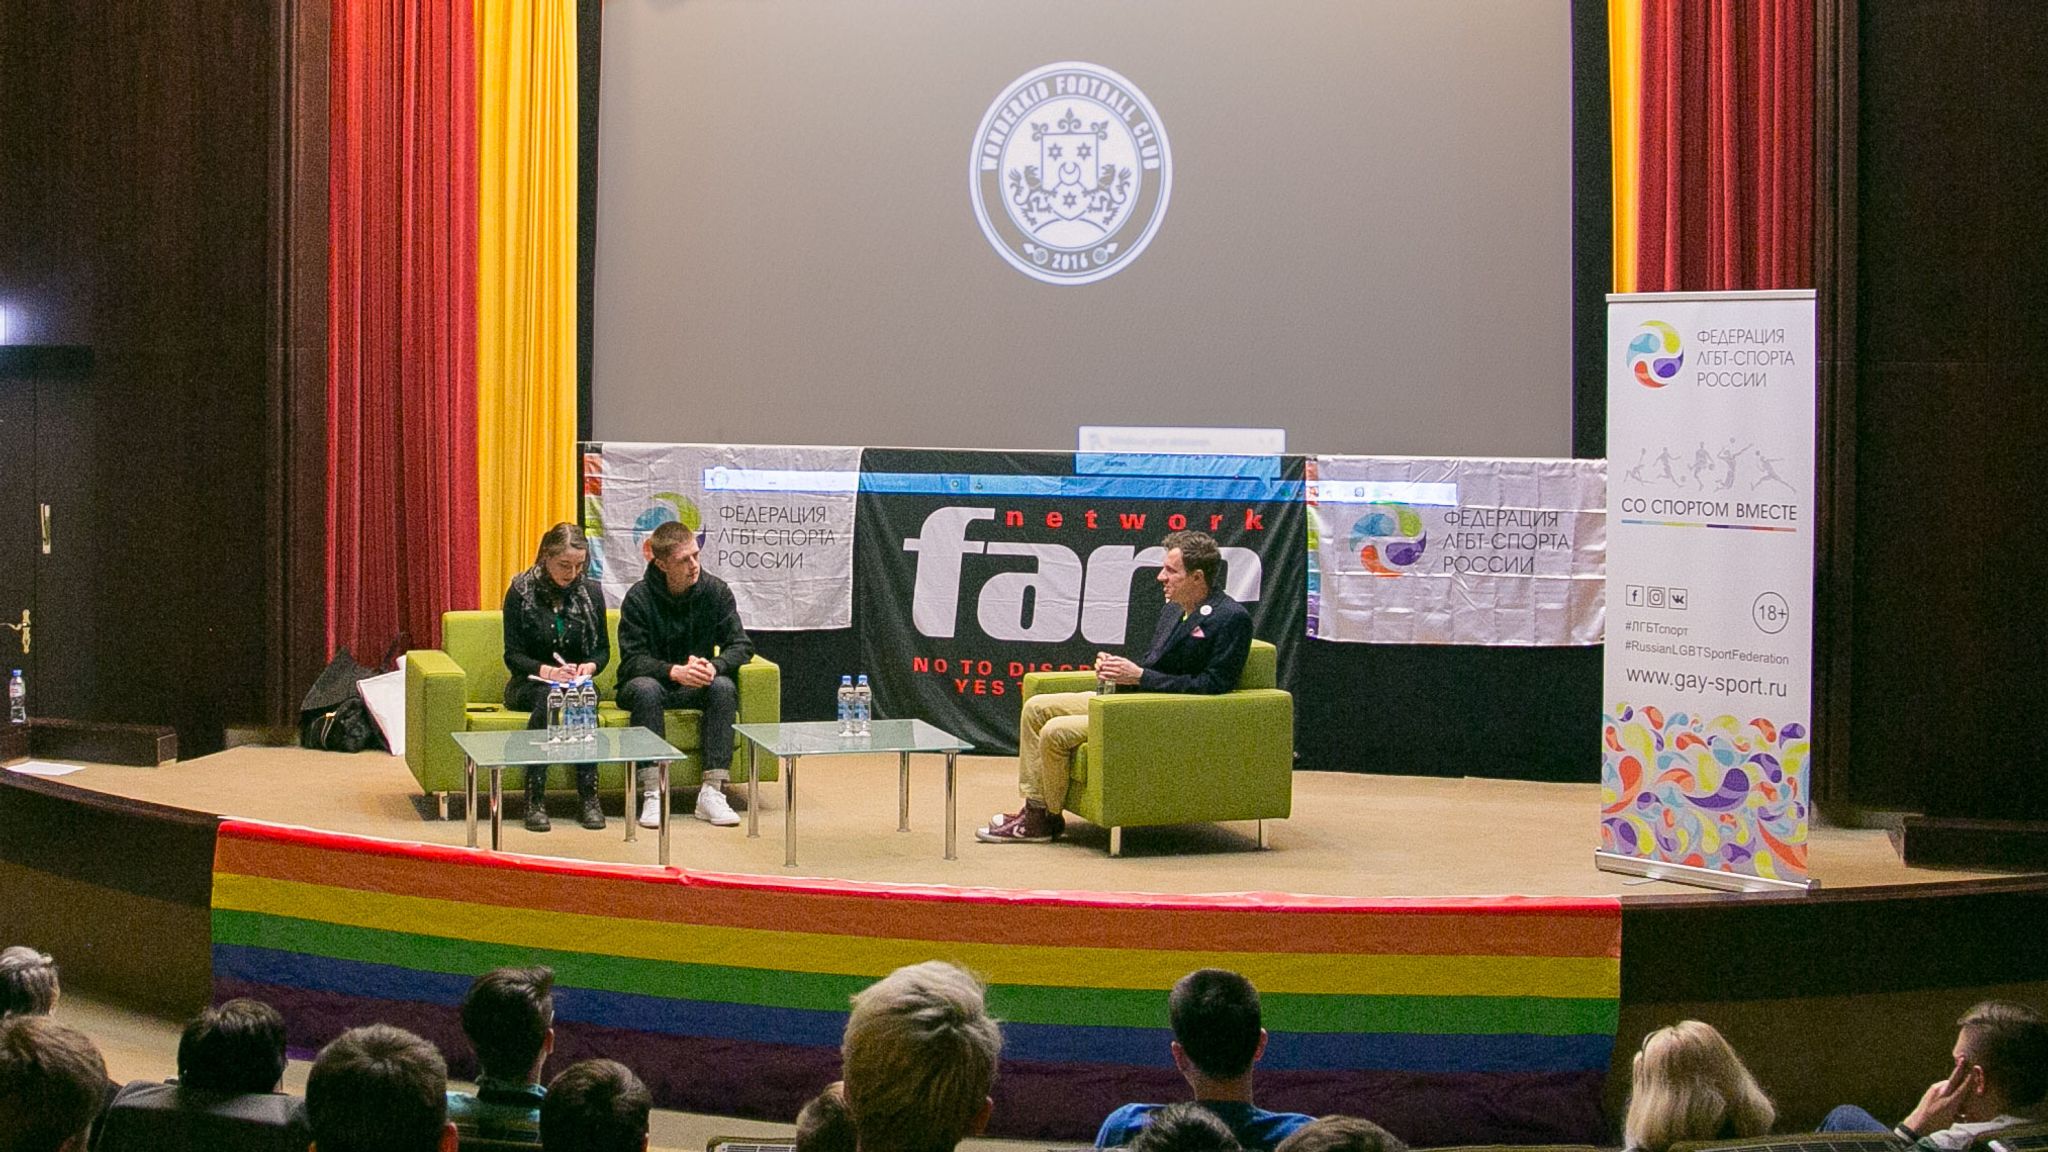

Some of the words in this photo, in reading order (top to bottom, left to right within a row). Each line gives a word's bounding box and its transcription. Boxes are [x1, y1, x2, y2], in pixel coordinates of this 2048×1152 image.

[981, 81, 1049, 171] WONDERKID
[1056, 75, 1137, 122] FOOTBALL
[1132, 121, 1160, 170] CLUB
[1051, 253, 1088, 270] 2016
[1696, 329, 1785, 346] ФЕДЕРАЦИЯ
[1696, 350, 1795, 367] ЛГБТ-СПОРТА
[1697, 372, 1767, 388] РОССИИ
[719, 505, 826, 525] ФЕДЕРАЦИЯ
[1443, 509, 1558, 528] ФЕДЕРАЦИЯ
[1621, 498, 1646, 513] СО
[1651, 499, 1729, 517] СПОРТОМ
[1736, 504, 1797, 520] ВМЕСТЕ
[1006, 508, 1265, 531] network
[718, 528, 835, 546] ЛГБТ-СПОРТА
[1443, 532, 1570, 551] ЛГБТ-СПОРТА
[718, 550, 803, 569] РОССИИ
[1443, 555, 1534, 574] РОССИИ
[902, 506, 1261, 645] far
[1759, 605, 1787, 621] 18+
[1625, 620, 1688, 637] #ЛГБТспорт
[1625, 640, 1789, 665] #RussianLGBTSportFederation
[913, 656, 948, 673] NO
[960, 660, 993, 676] TO
[954, 678, 1005, 696] YES
[1626, 668, 1787, 697] www.gay-sport.ru
